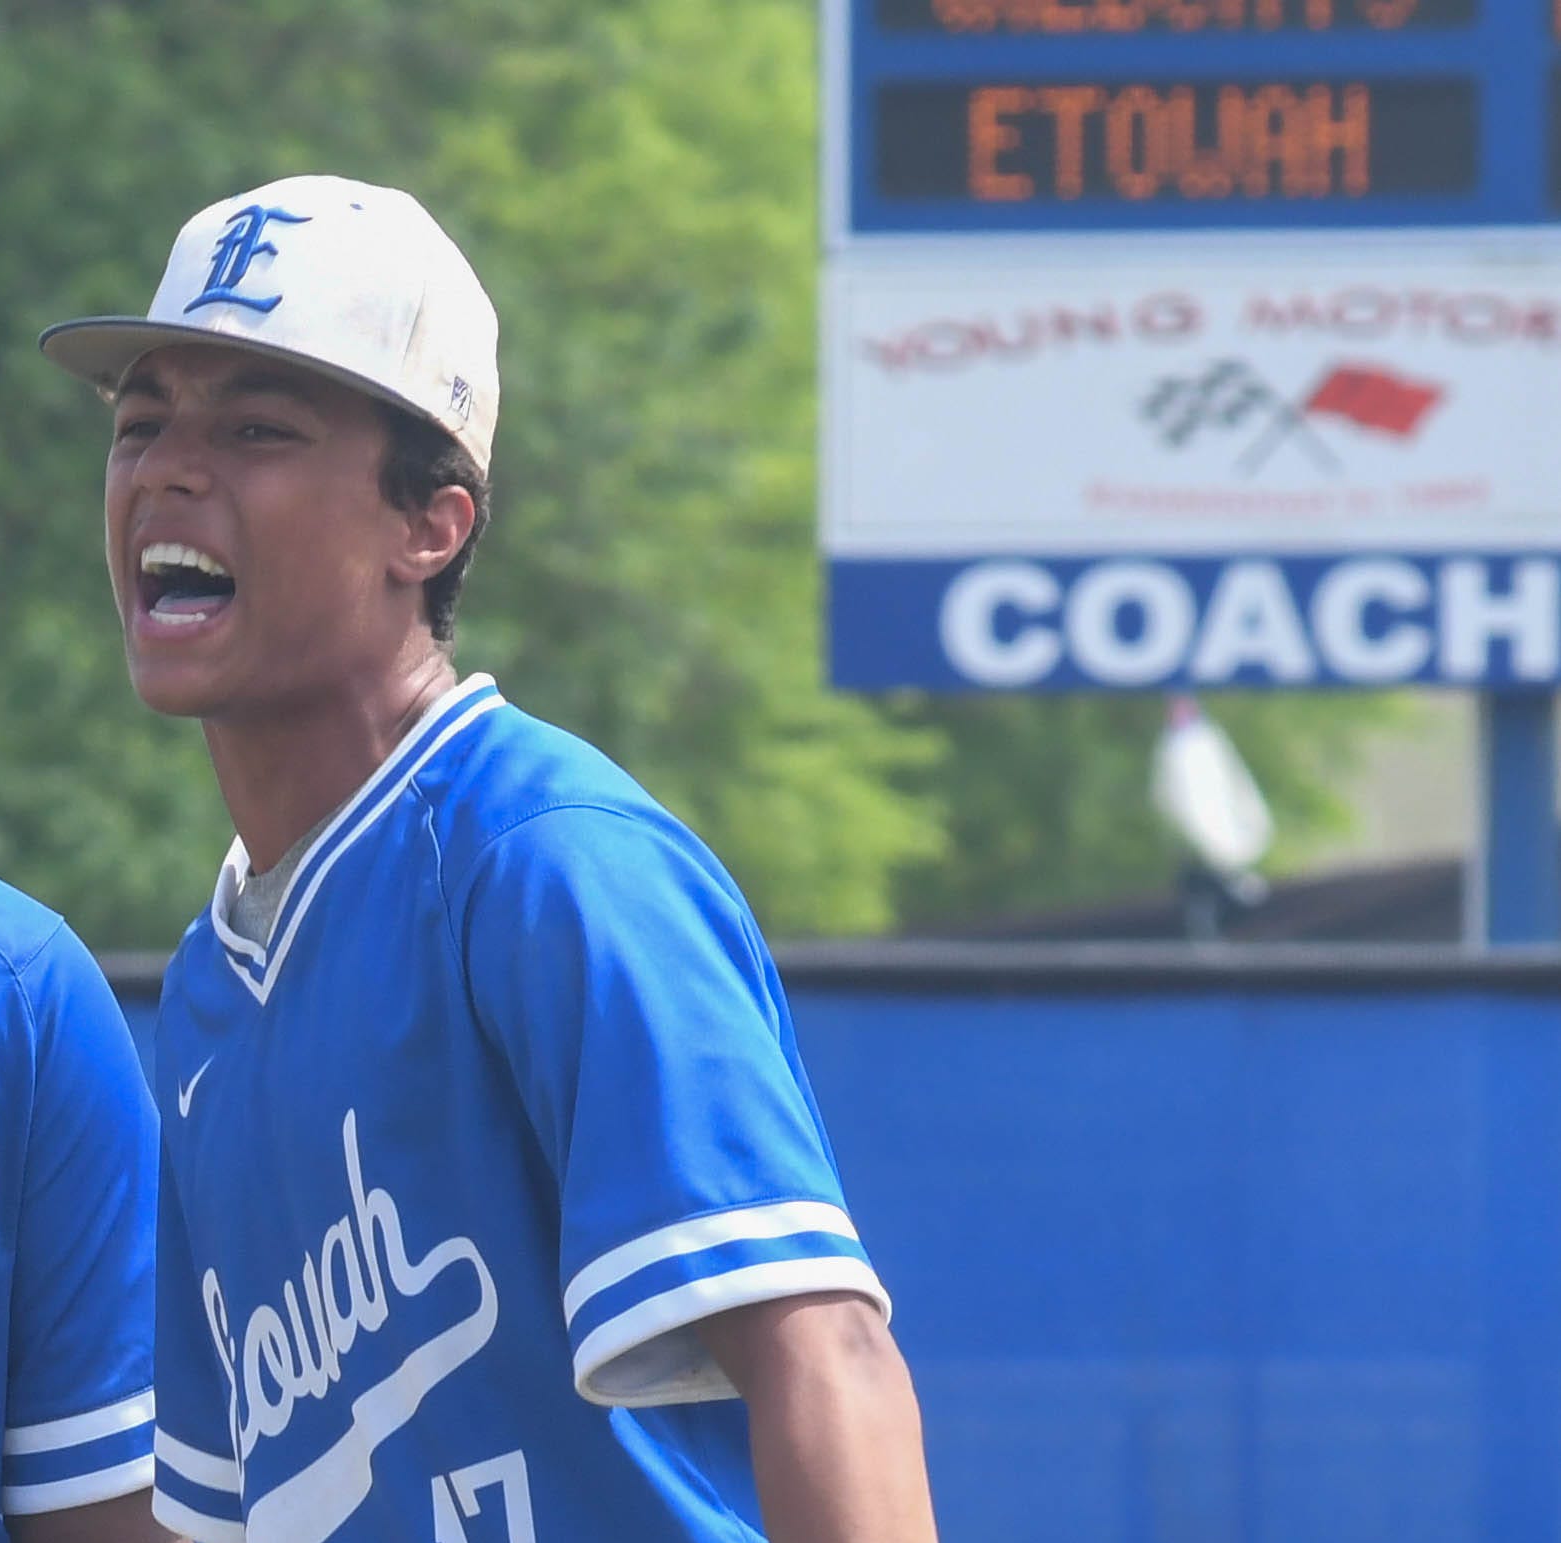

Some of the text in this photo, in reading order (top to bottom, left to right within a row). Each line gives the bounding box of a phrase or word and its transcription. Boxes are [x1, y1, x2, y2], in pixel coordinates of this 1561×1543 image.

[967, 84, 1371, 202] ETOWAH
[184, 204, 312, 314] E
[863, 290, 1204, 376] YOUNG
[940, 557, 1560, 687] COACH
